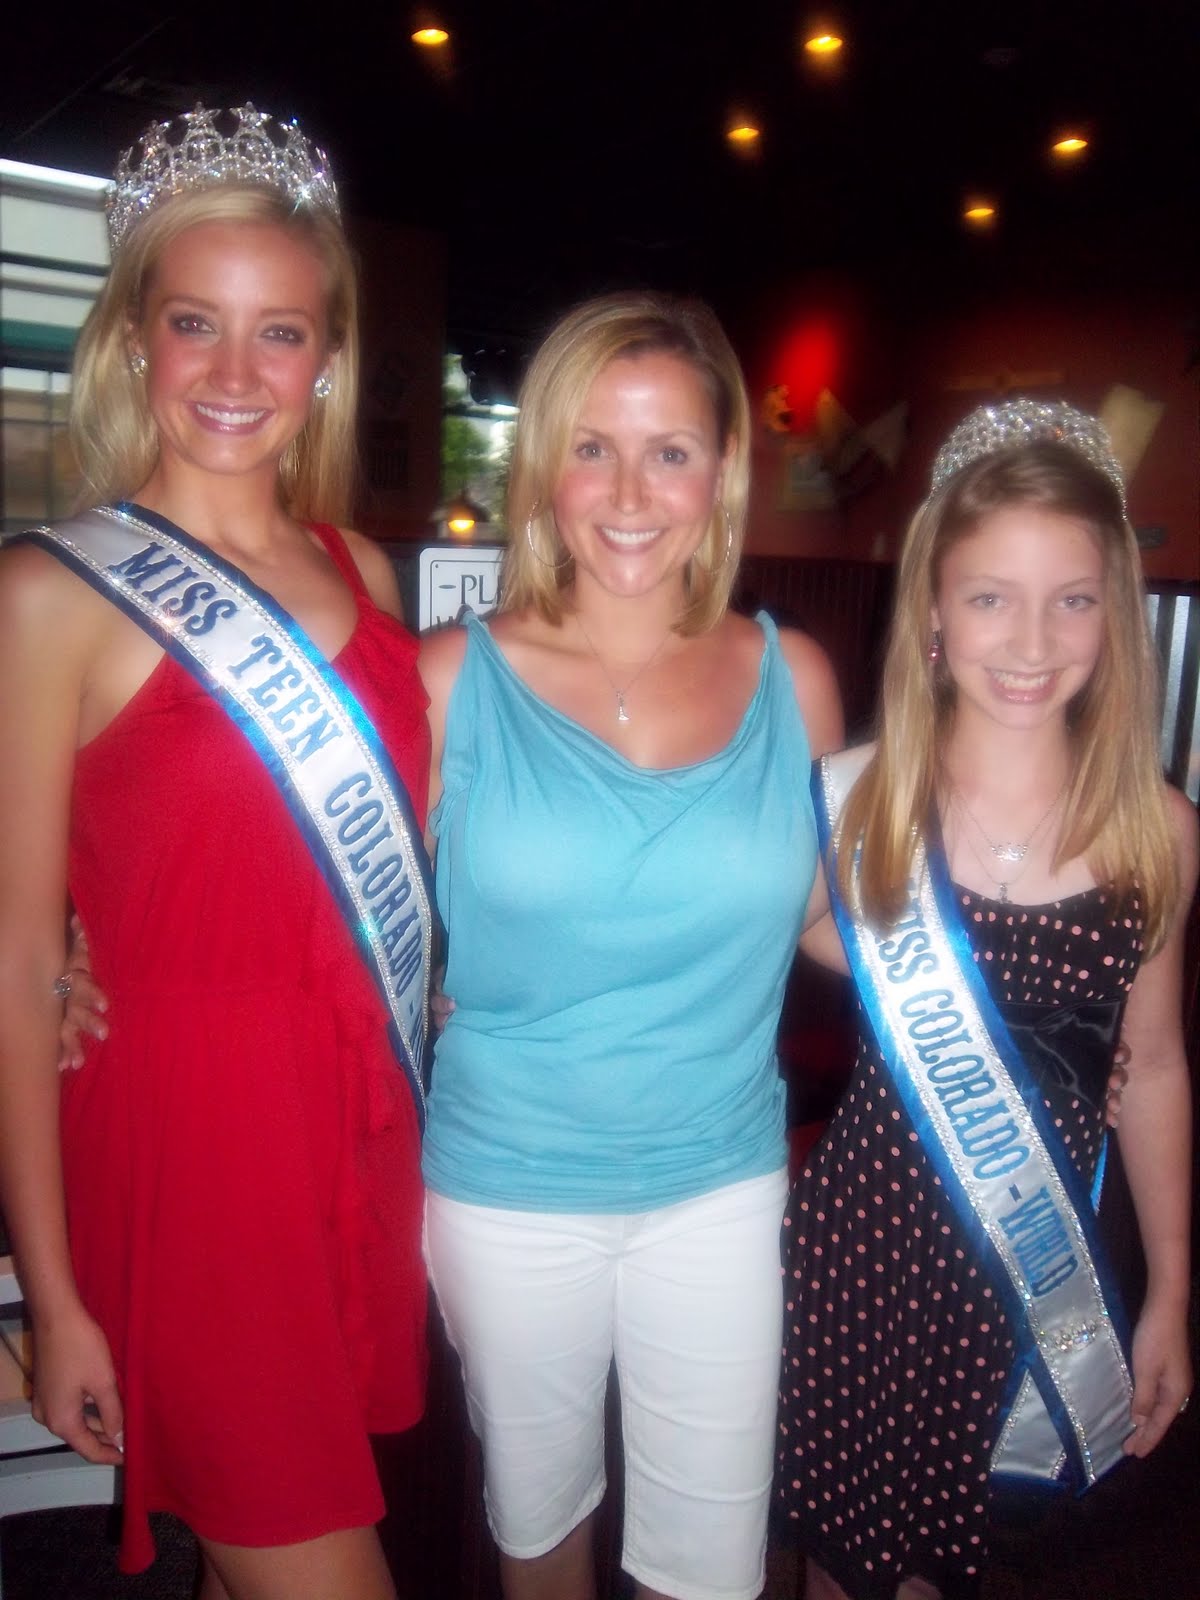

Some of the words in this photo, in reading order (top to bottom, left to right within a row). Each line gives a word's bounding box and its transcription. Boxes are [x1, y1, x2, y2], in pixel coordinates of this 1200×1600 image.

[107, 541, 239, 636] MISS
[226, 632, 343, 764] TEEN
[324, 771, 424, 998] COLORADO
[900, 988, 1031, 1180] COLORADO
[997, 1185, 1079, 1298] WORLD
